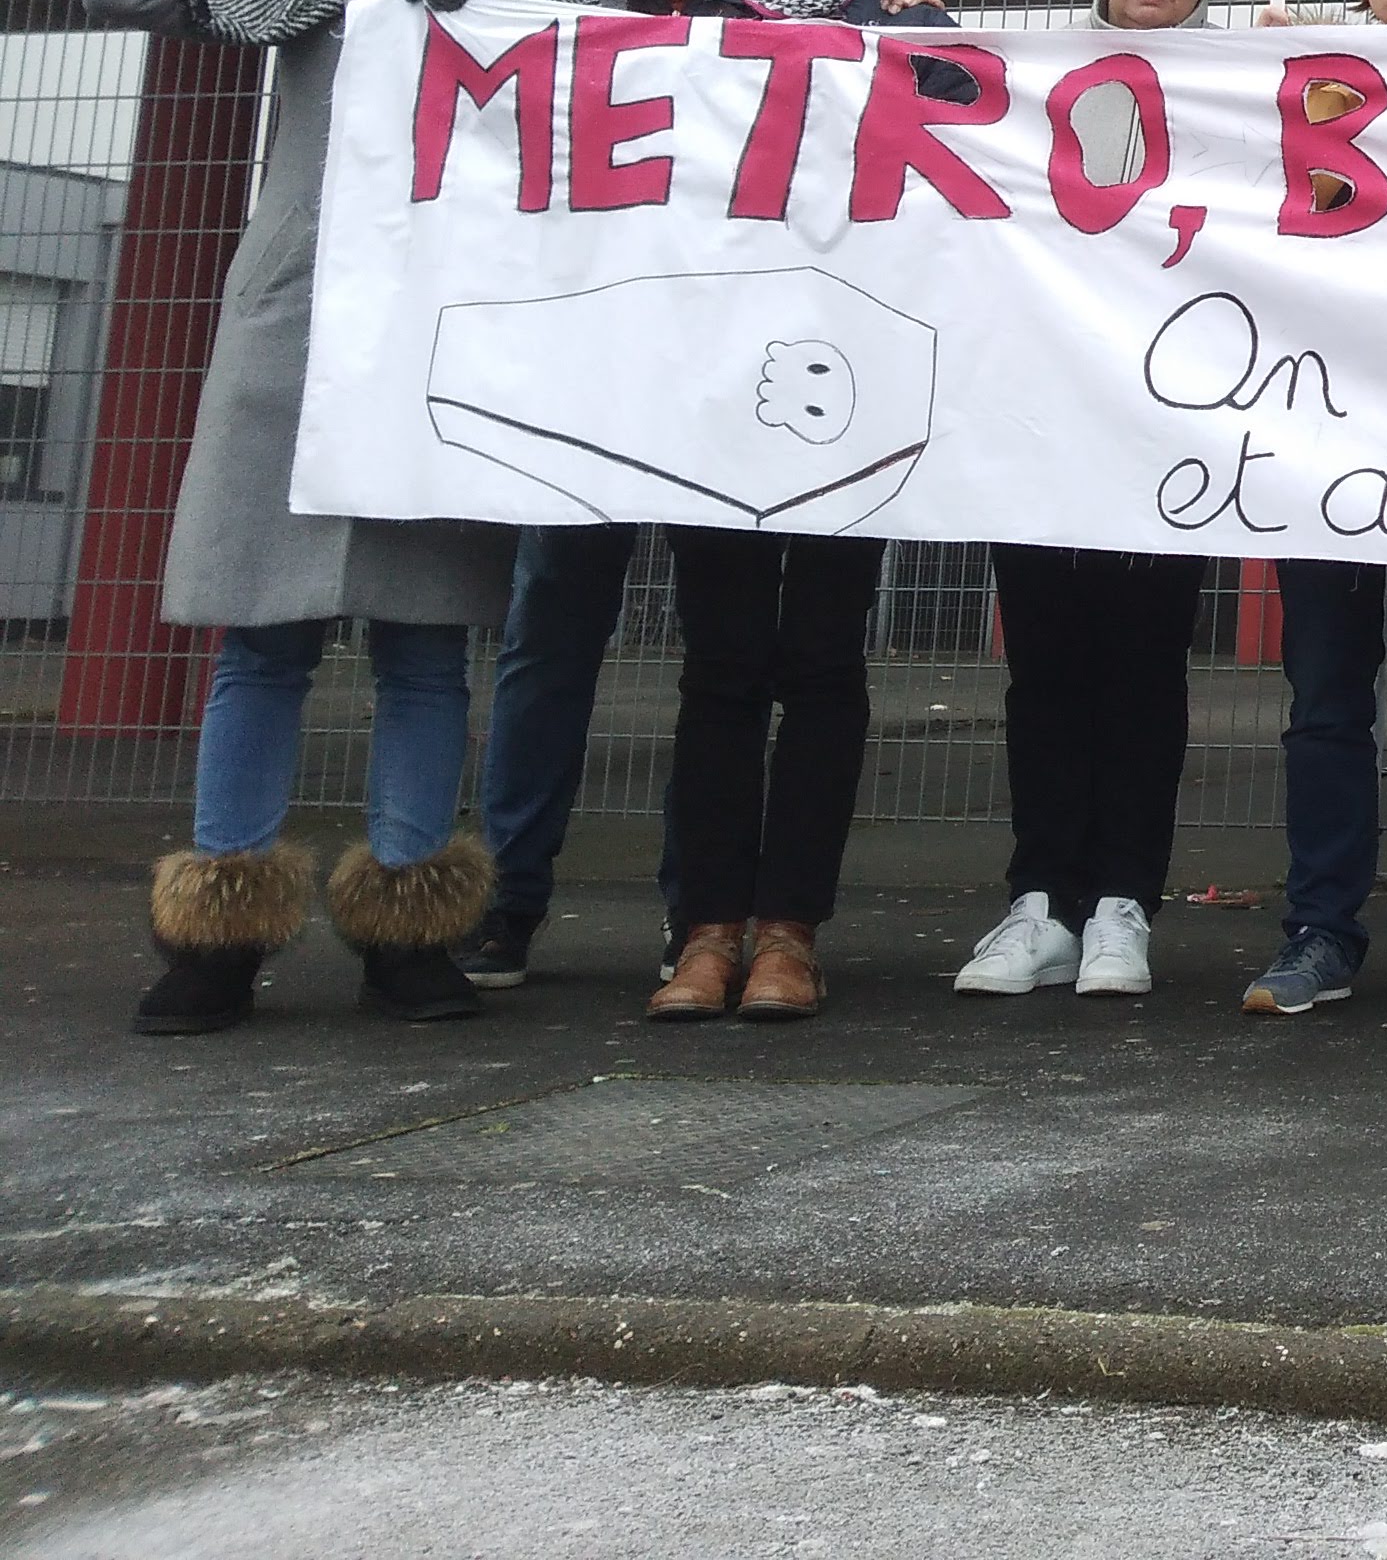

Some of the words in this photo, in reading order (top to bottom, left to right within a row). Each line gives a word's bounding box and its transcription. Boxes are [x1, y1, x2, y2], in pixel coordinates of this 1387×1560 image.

[409, 7, 1208, 269] METRO,
[1142, 291, 1348, 420] On
[1154, 431, 1290, 534] et
